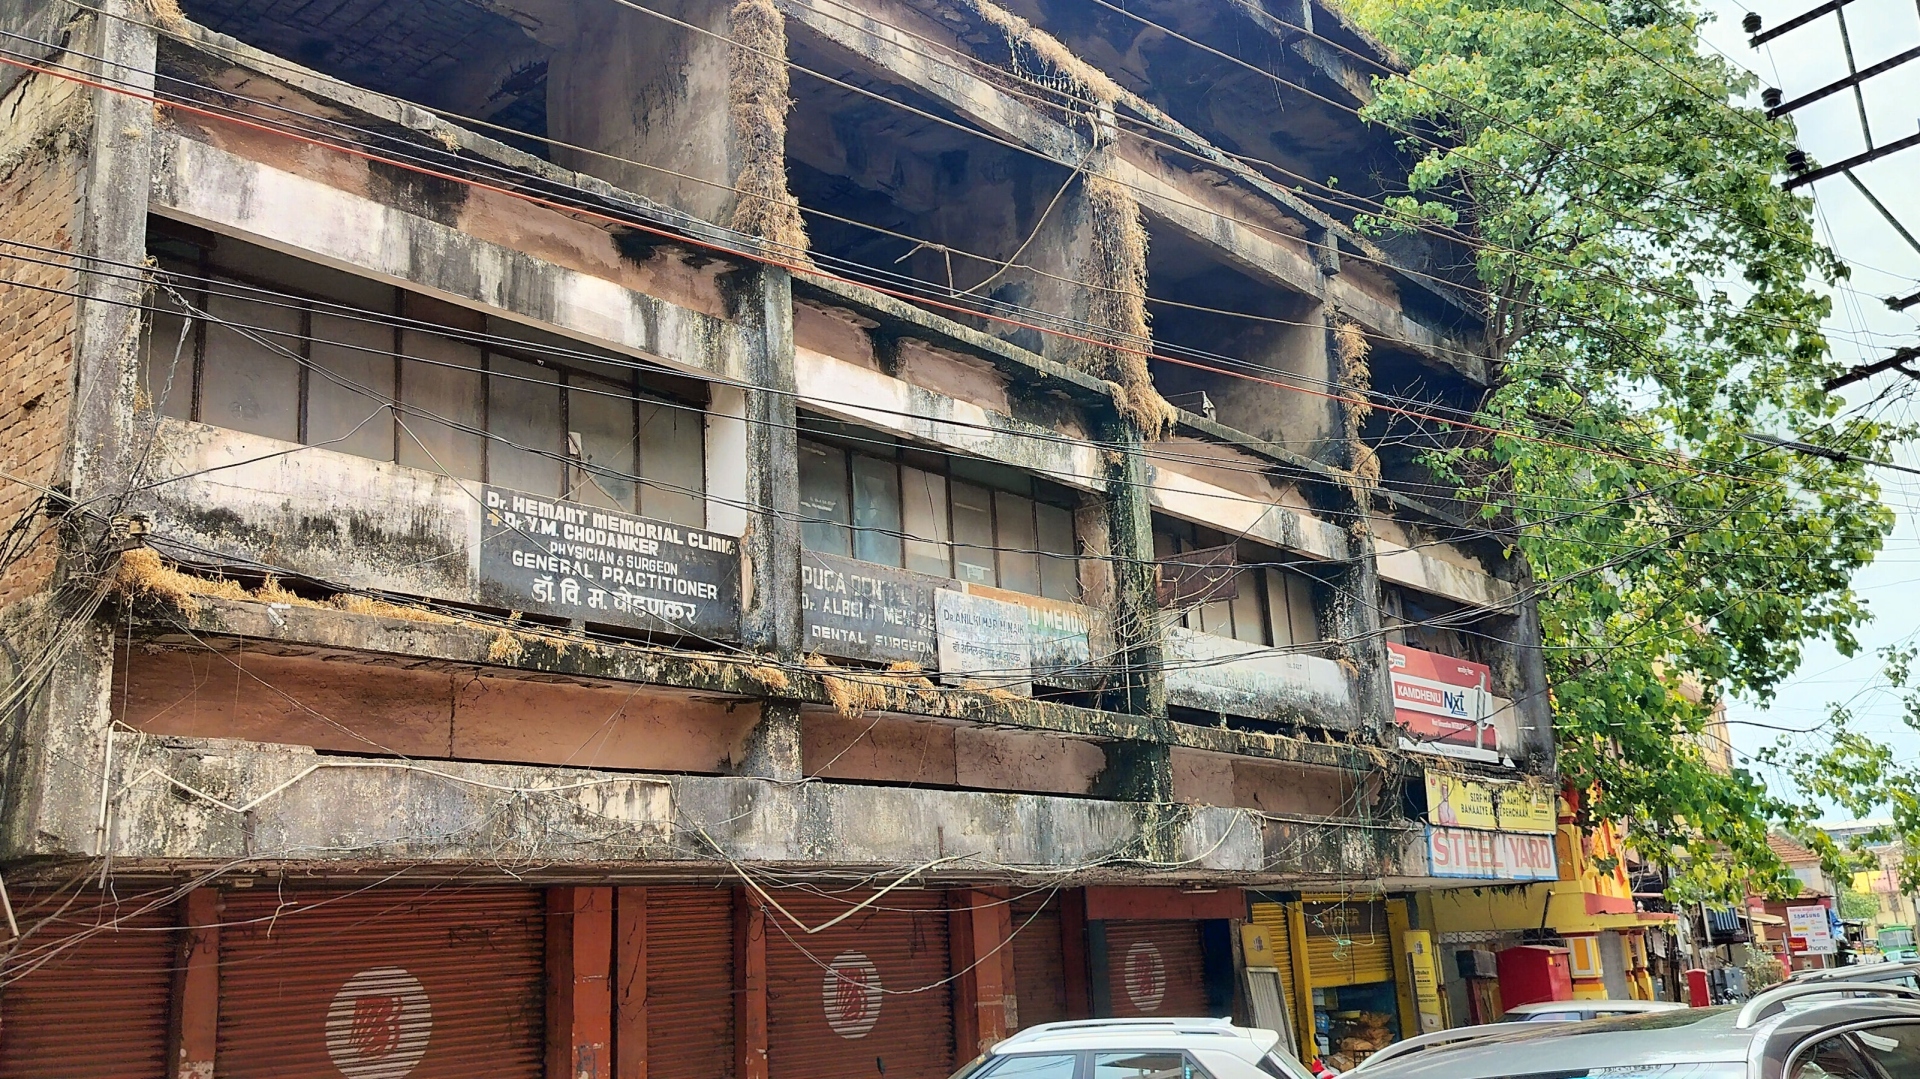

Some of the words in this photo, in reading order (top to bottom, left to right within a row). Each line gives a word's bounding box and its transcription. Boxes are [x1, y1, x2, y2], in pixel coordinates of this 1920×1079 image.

[487, 491, 509, 511] Dr.
[563, 523, 659, 557] CHODANKER
[512, 550, 594, 579] GENERAL
[602, 566, 718, 600] PRACTITIONER
[550, 541, 614, 566] PHYSICIAN
[626, 554, 678, 576] SURGEON
[811, 624, 867, 645] DENTAL
[875, 634, 934, 655] SURGEON
[1397, 684, 1442, 704] KAMDHENU
[1432, 832, 1504, 869] STEEL
[1508, 836, 1551, 870] YARD
